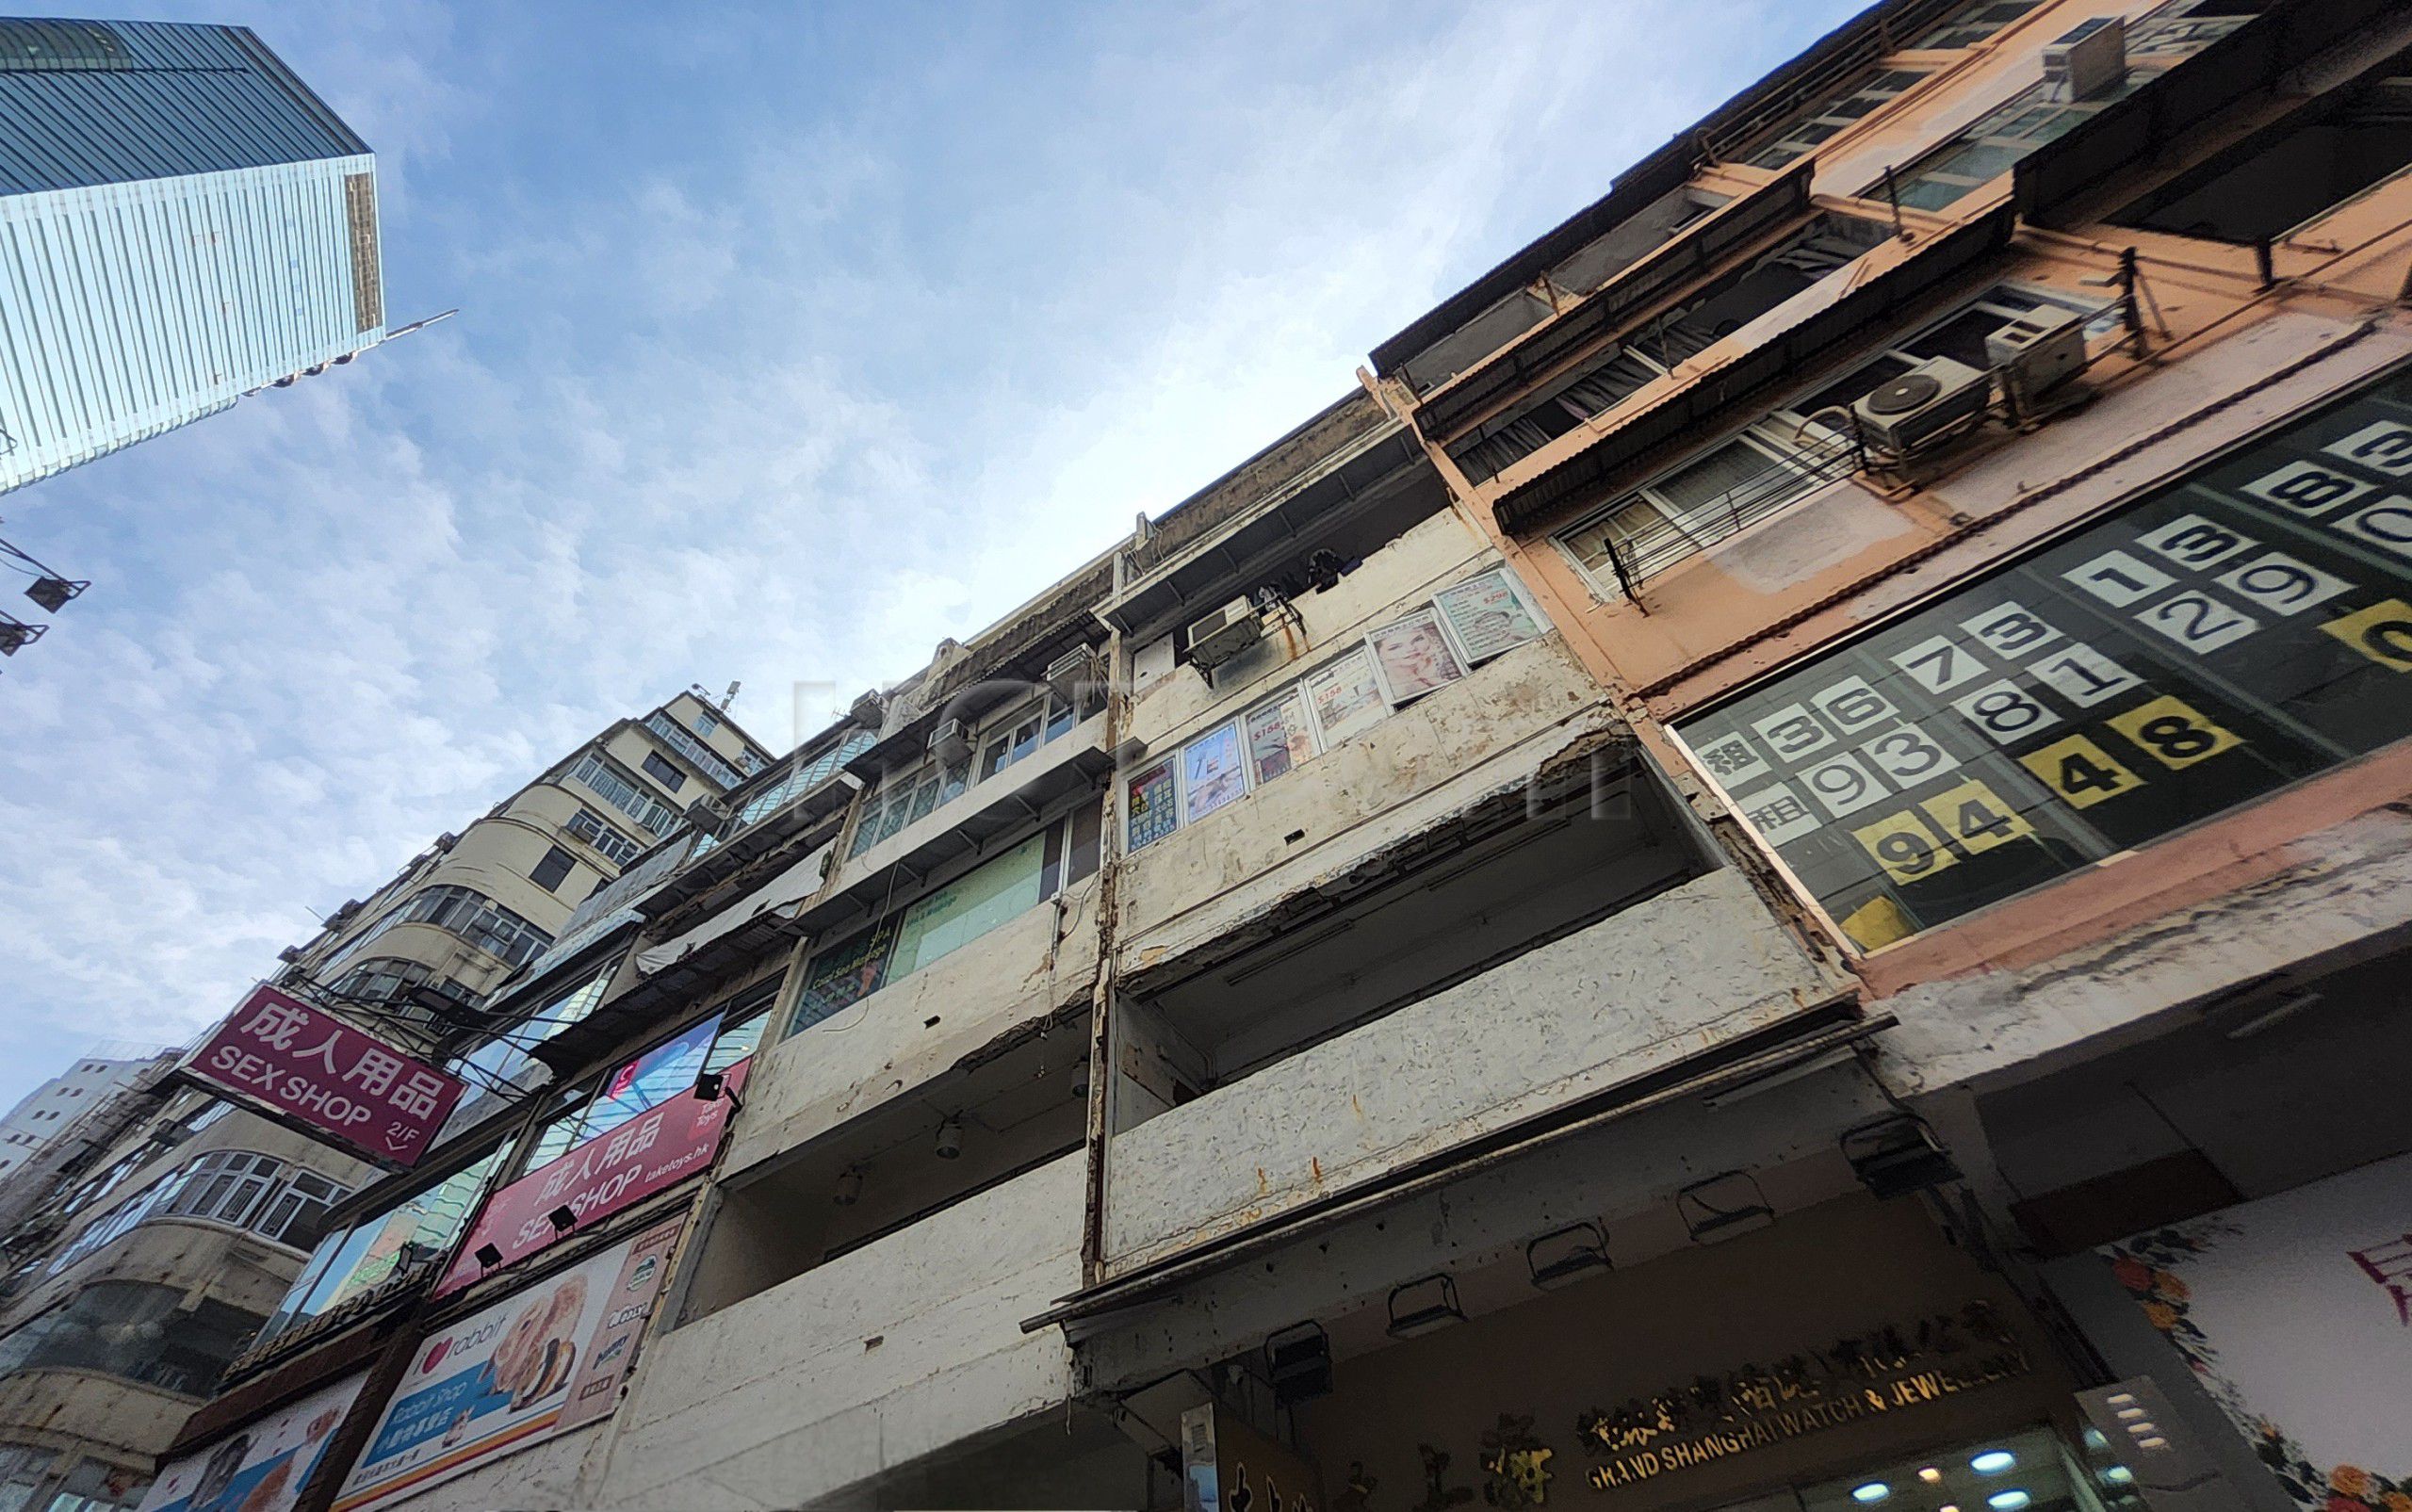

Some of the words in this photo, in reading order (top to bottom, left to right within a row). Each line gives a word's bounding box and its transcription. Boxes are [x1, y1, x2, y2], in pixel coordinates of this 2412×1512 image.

[211, 1046, 286, 1091] SEX
[280, 1077, 372, 1127] SHOP
[240, 1002, 445, 1121] 成人用品
[386, 1121, 420, 1143] 2/F
[533, 1113, 665, 1207] 成人用品
[569, 1164, 644, 1217] SHOP
[446, 1312, 509, 1360] rabbit
[1660, 1420, 1780, 1471] SHANGHAI
[1777, 1394, 1866, 1439] WATCH
[1862, 1388, 1890, 1414] &
